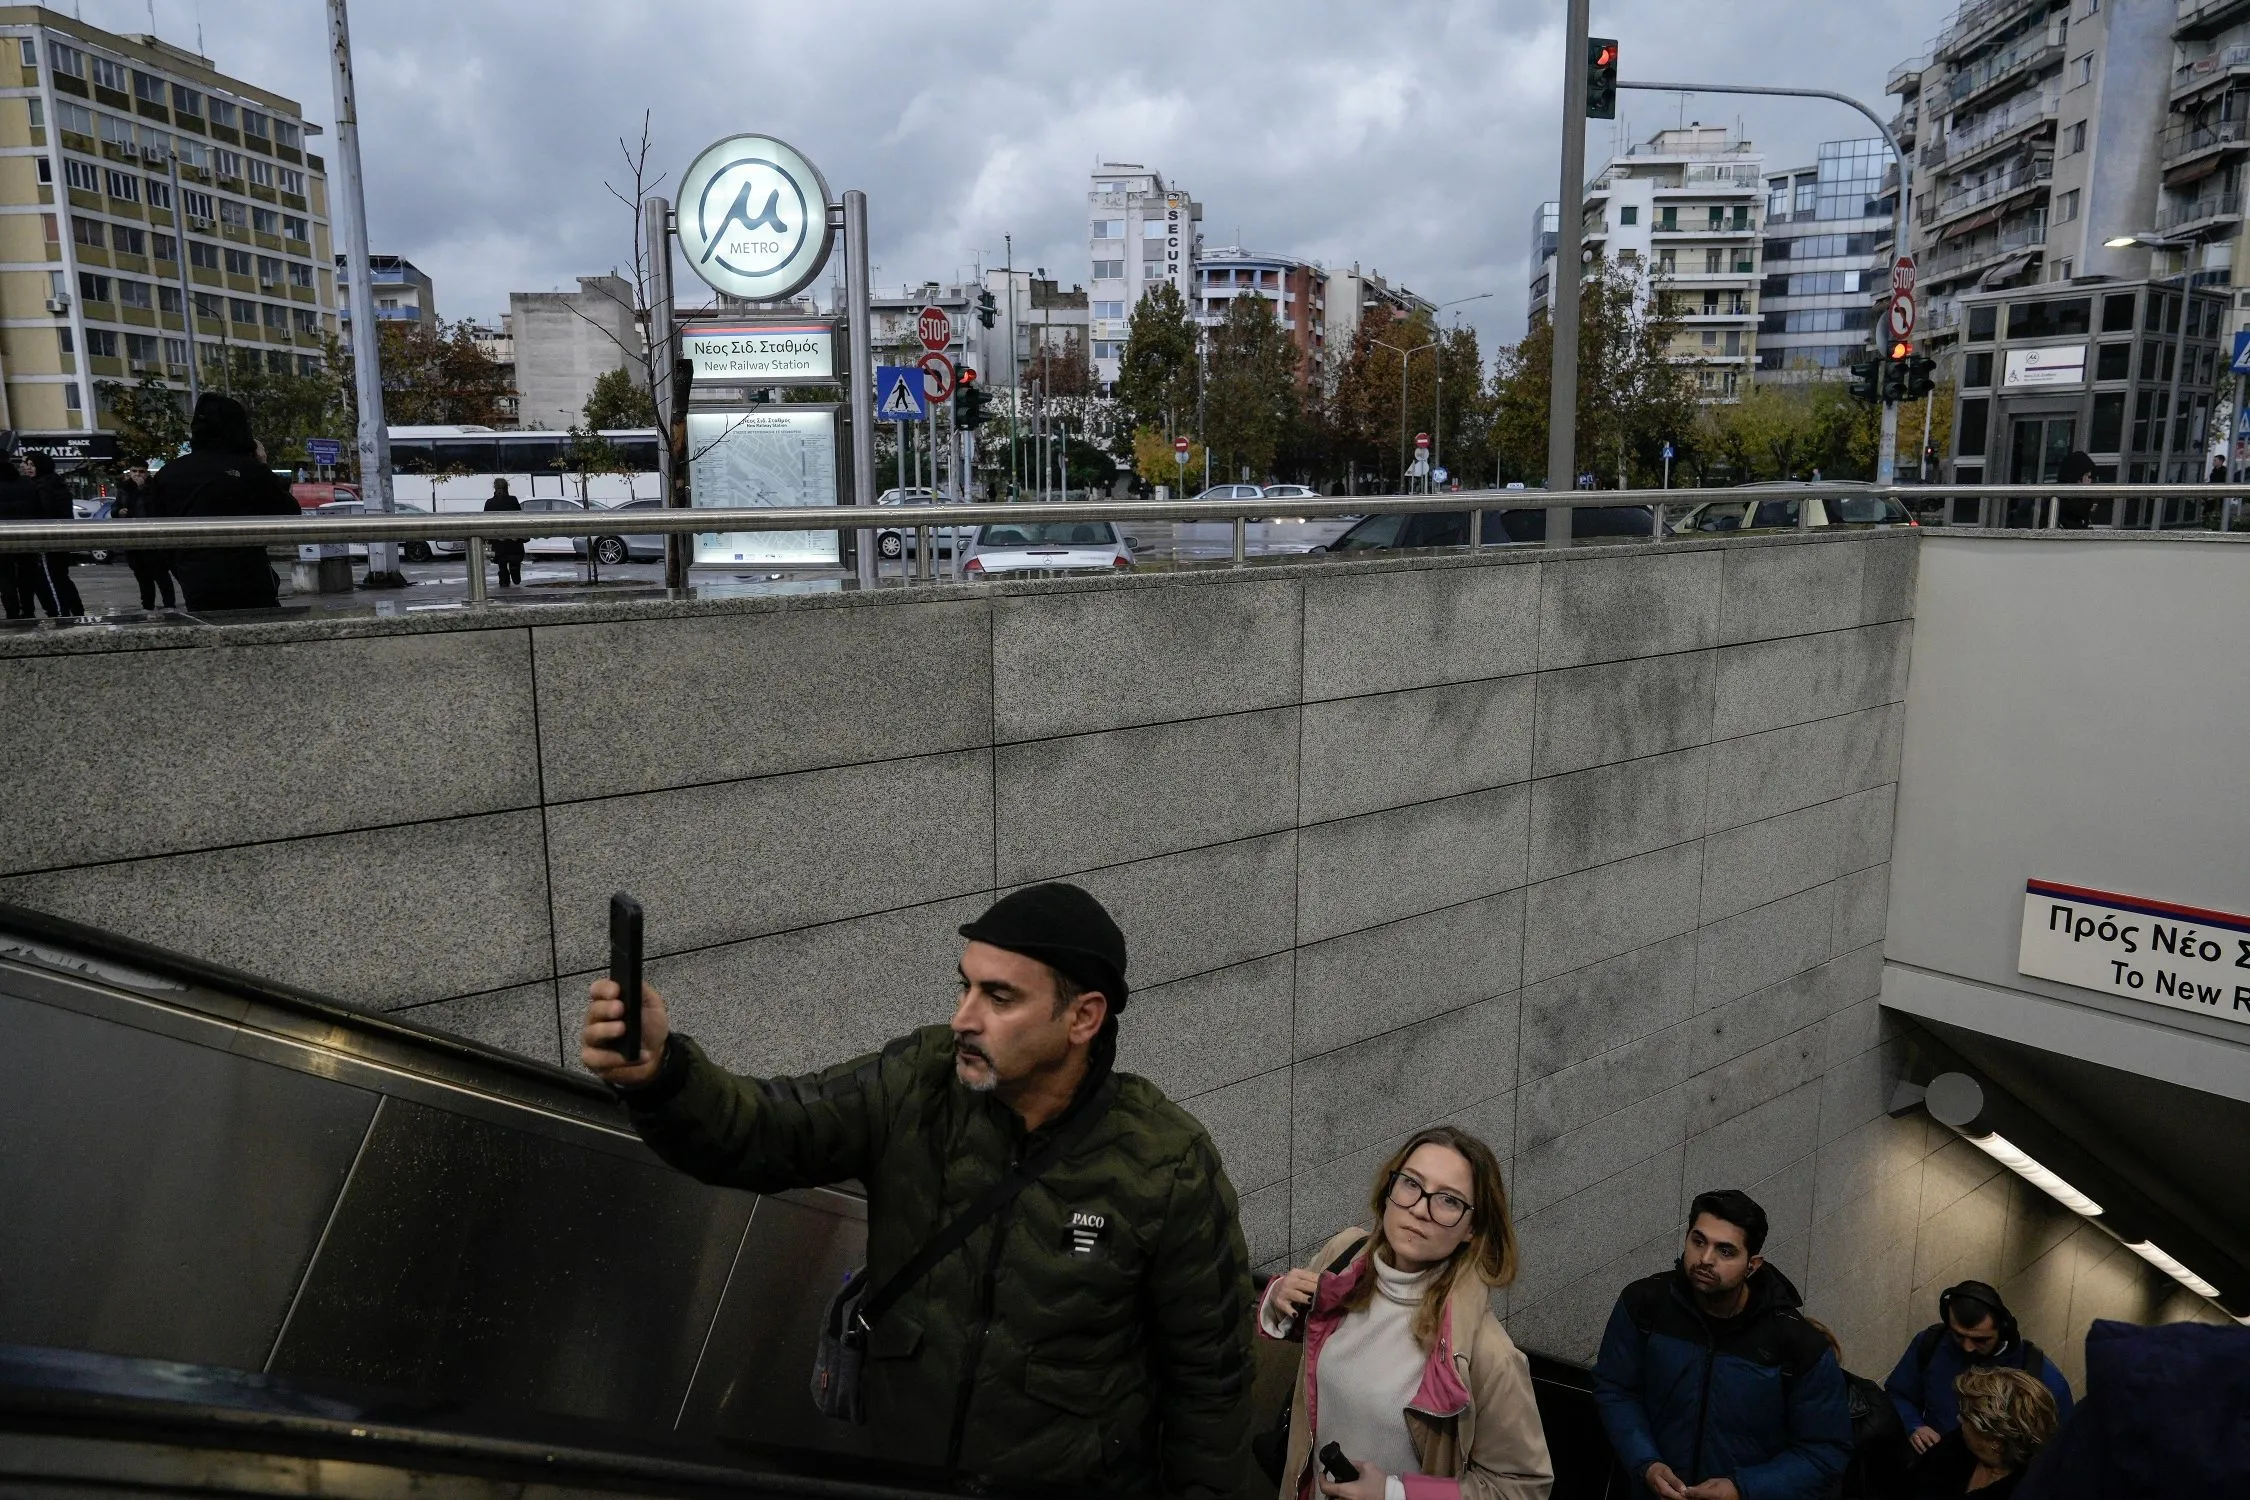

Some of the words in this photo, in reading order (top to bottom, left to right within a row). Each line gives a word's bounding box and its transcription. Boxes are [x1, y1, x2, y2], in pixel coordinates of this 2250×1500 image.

[730, 241, 780, 254] METRO
[1894, 267, 1914, 288] STOP
[920, 318, 948, 341] STOP
[694, 341, 729, 356] Νέος
[731, 341, 757, 354] Σιδ.
[760, 339, 819, 355] Σταθμός
[704, 361, 728, 371] New
[730, 360, 770, 372] Railway
[772, 359, 810, 370] Station
[2049, 904, 2140, 953] Πρός
[2151, 923, 2222, 962] Νέο
[2111, 960, 2144, 989] To
[2155, 970, 2223, 1006] New
[1072, 1212, 1105, 1228] PACO
